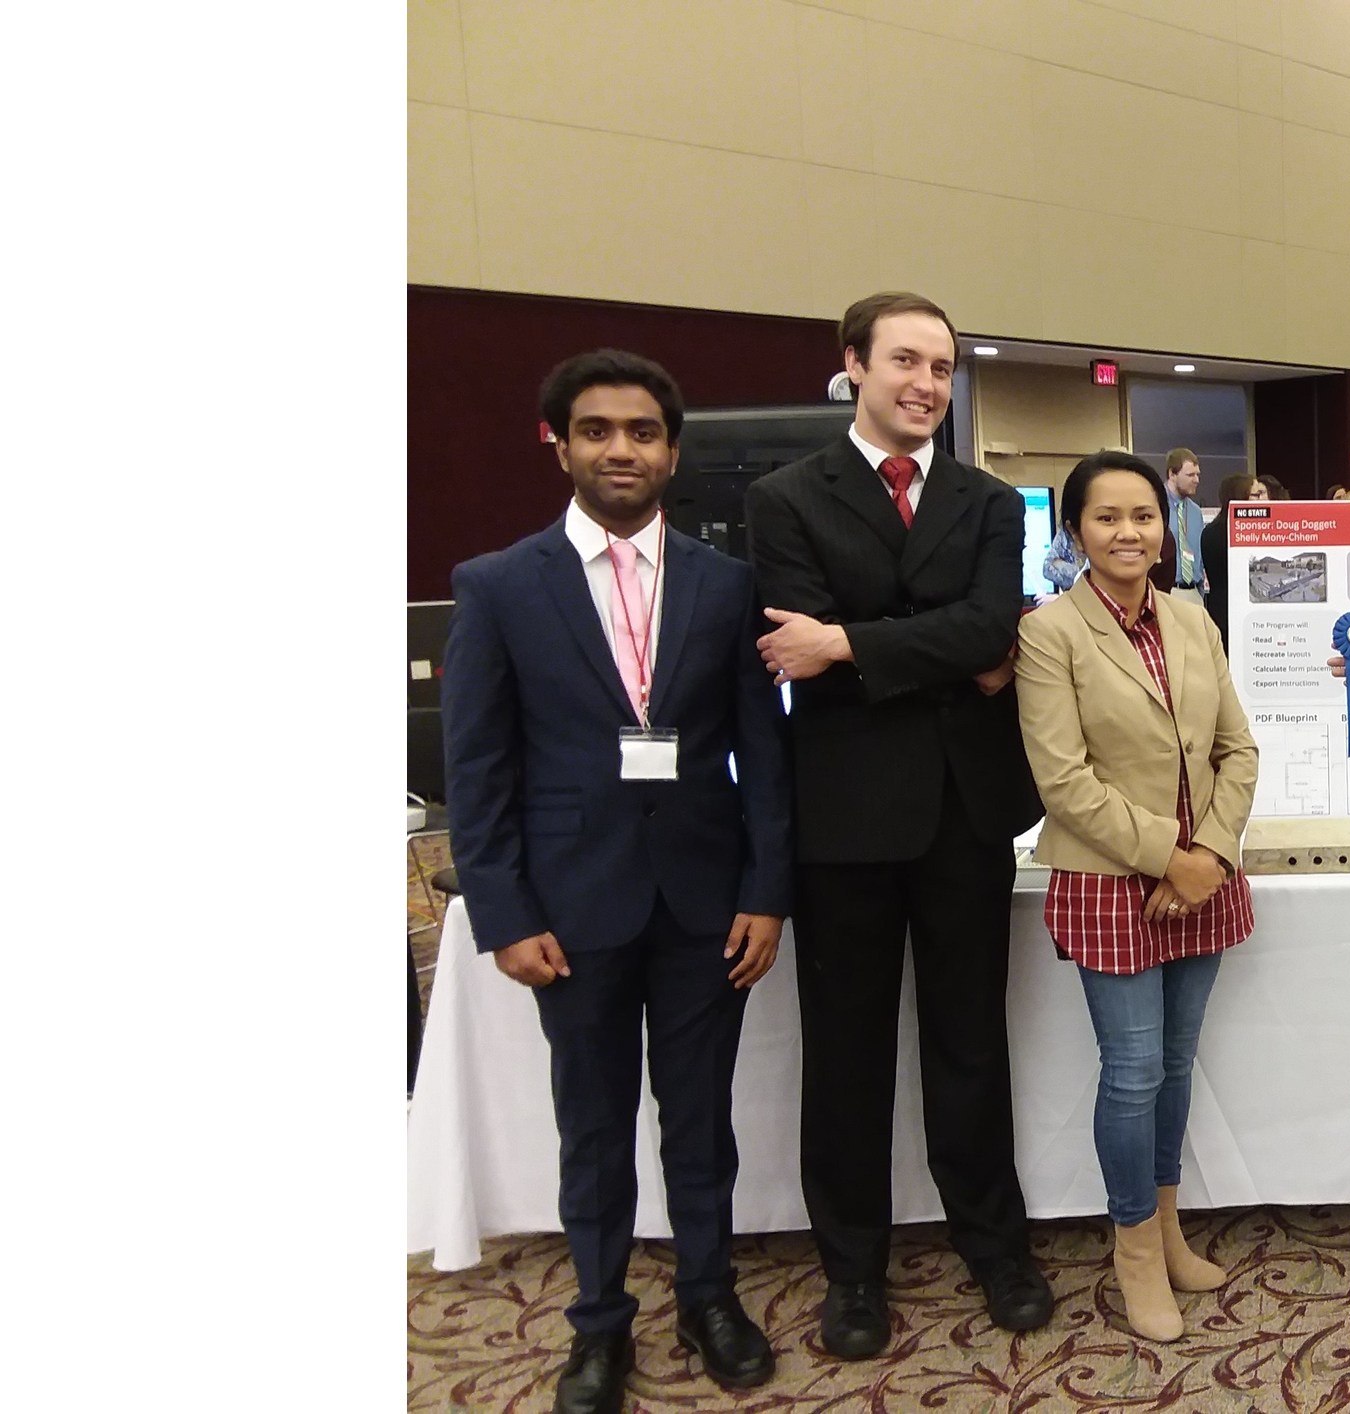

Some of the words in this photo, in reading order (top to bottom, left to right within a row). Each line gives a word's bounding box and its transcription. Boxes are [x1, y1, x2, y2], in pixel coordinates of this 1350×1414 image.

[1237, 509, 1247, 517] NC
[1248, 509, 1267, 517] STATE
[1235, 520, 1274, 531] Sponsor:
[1276, 520, 1299, 531] Doug
[1301, 520, 1337, 531] Doggett
[1235, 533, 1260, 543] Shelly
[1261, 532, 1319, 543] Mony-Chhem
[1266, 622, 1295, 630] Program
[1286, 651, 1311, 659] layouts
[1255, 680, 1278, 688] Export
[1255, 714, 1273, 722] PDF
[1275, 713, 1318, 724] Blueprint
